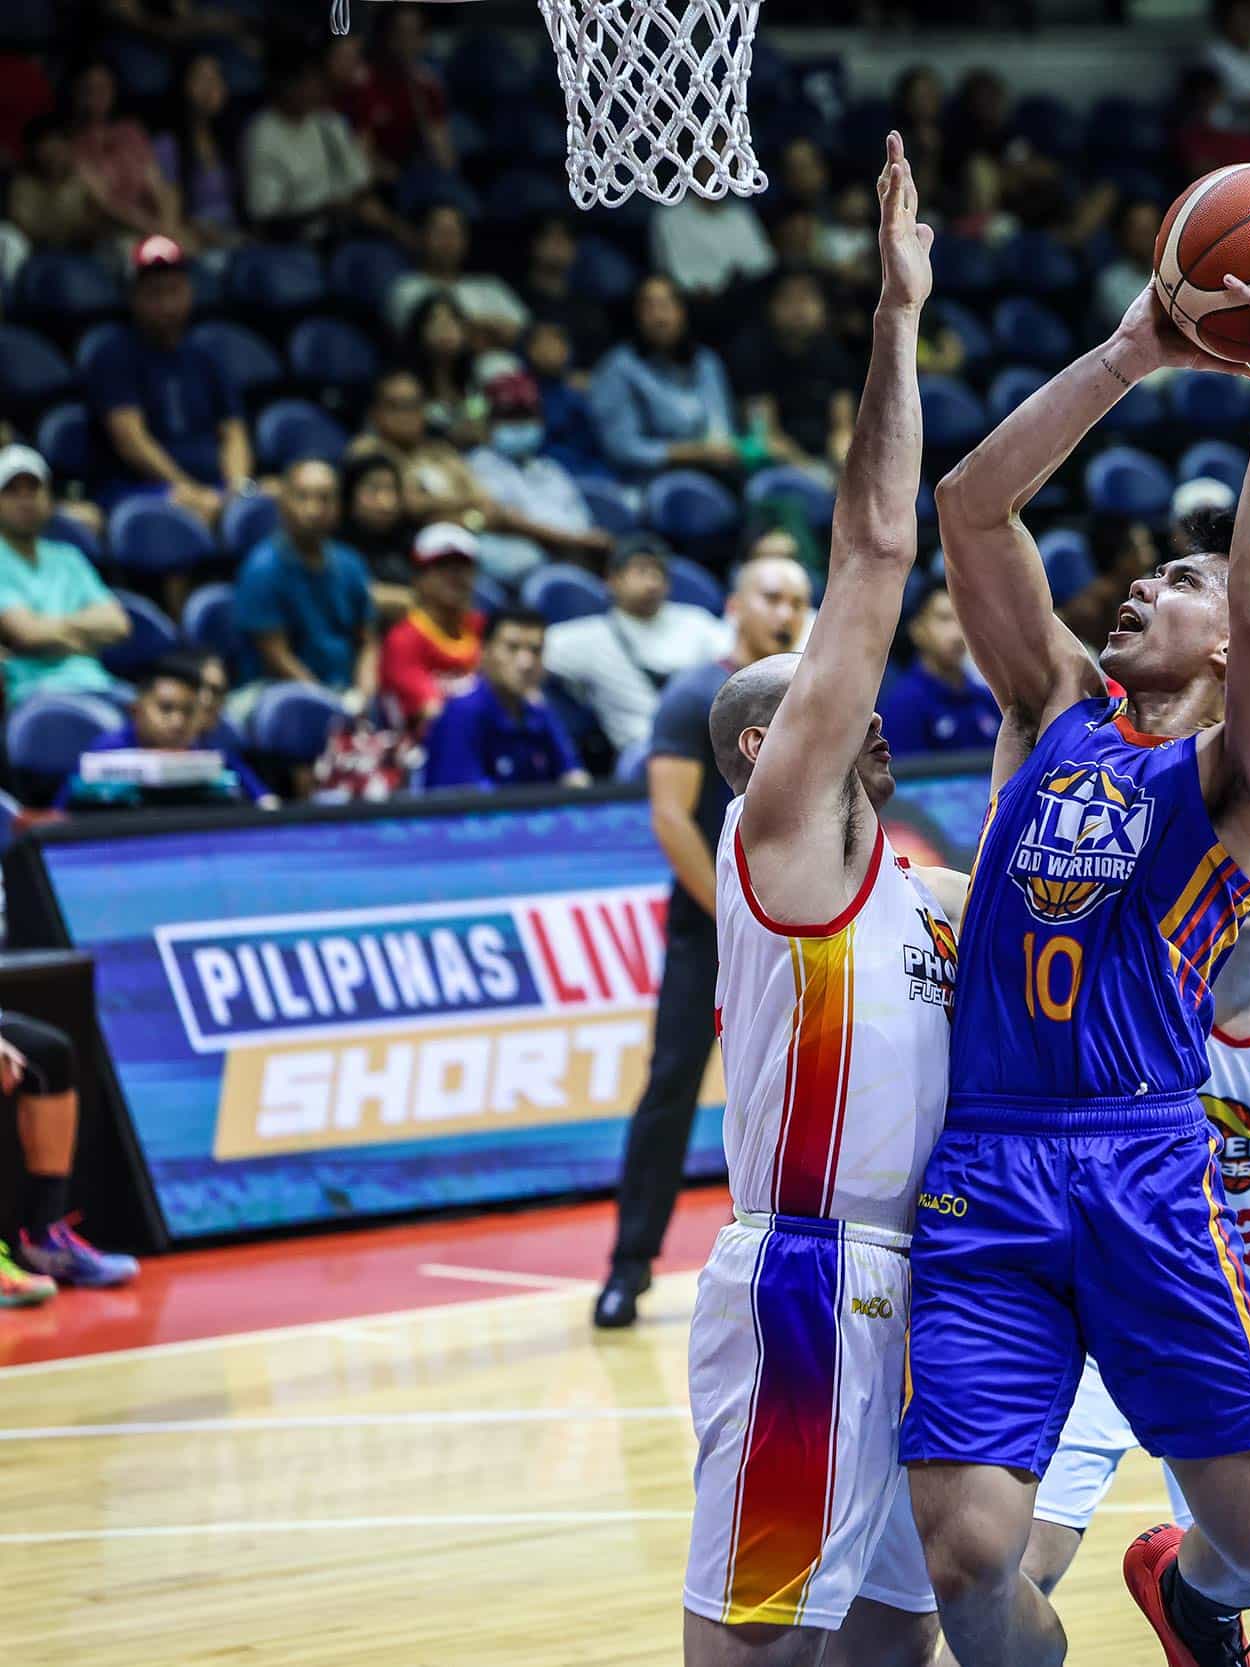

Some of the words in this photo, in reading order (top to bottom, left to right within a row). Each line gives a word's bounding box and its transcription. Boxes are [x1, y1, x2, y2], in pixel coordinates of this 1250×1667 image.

[193, 925, 519, 1026] PILIPINAS
[903, 945, 958, 983] PHO
[1023, 932, 1082, 1021] 10
